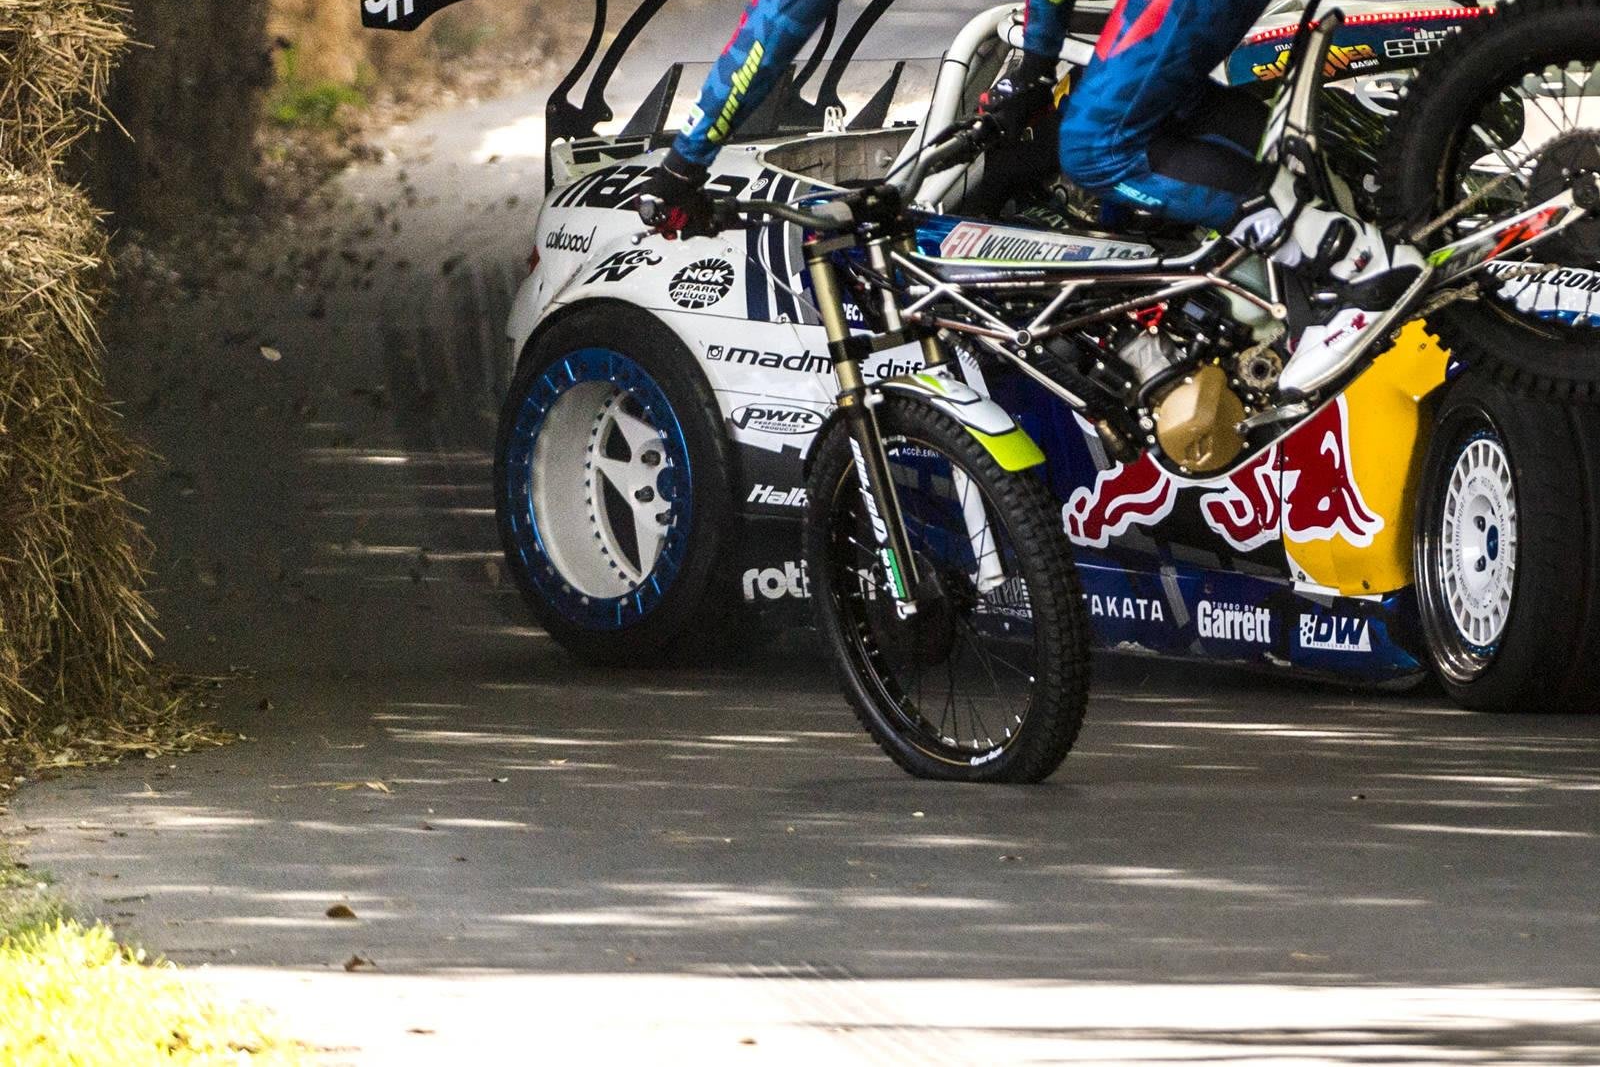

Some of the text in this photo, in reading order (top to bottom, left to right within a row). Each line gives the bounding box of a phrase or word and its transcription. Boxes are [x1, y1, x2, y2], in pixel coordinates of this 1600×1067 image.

[681, 268, 729, 283] NGK
[678, 283, 719, 294] SPARK
[674, 291, 716, 302] PLUGS
[740, 407, 819, 430] PWR
[1212, 601, 1255, 613] TURBO BY
[1197, 600, 1271, 644] Garrett
[1313, 615, 1366, 645] DW
